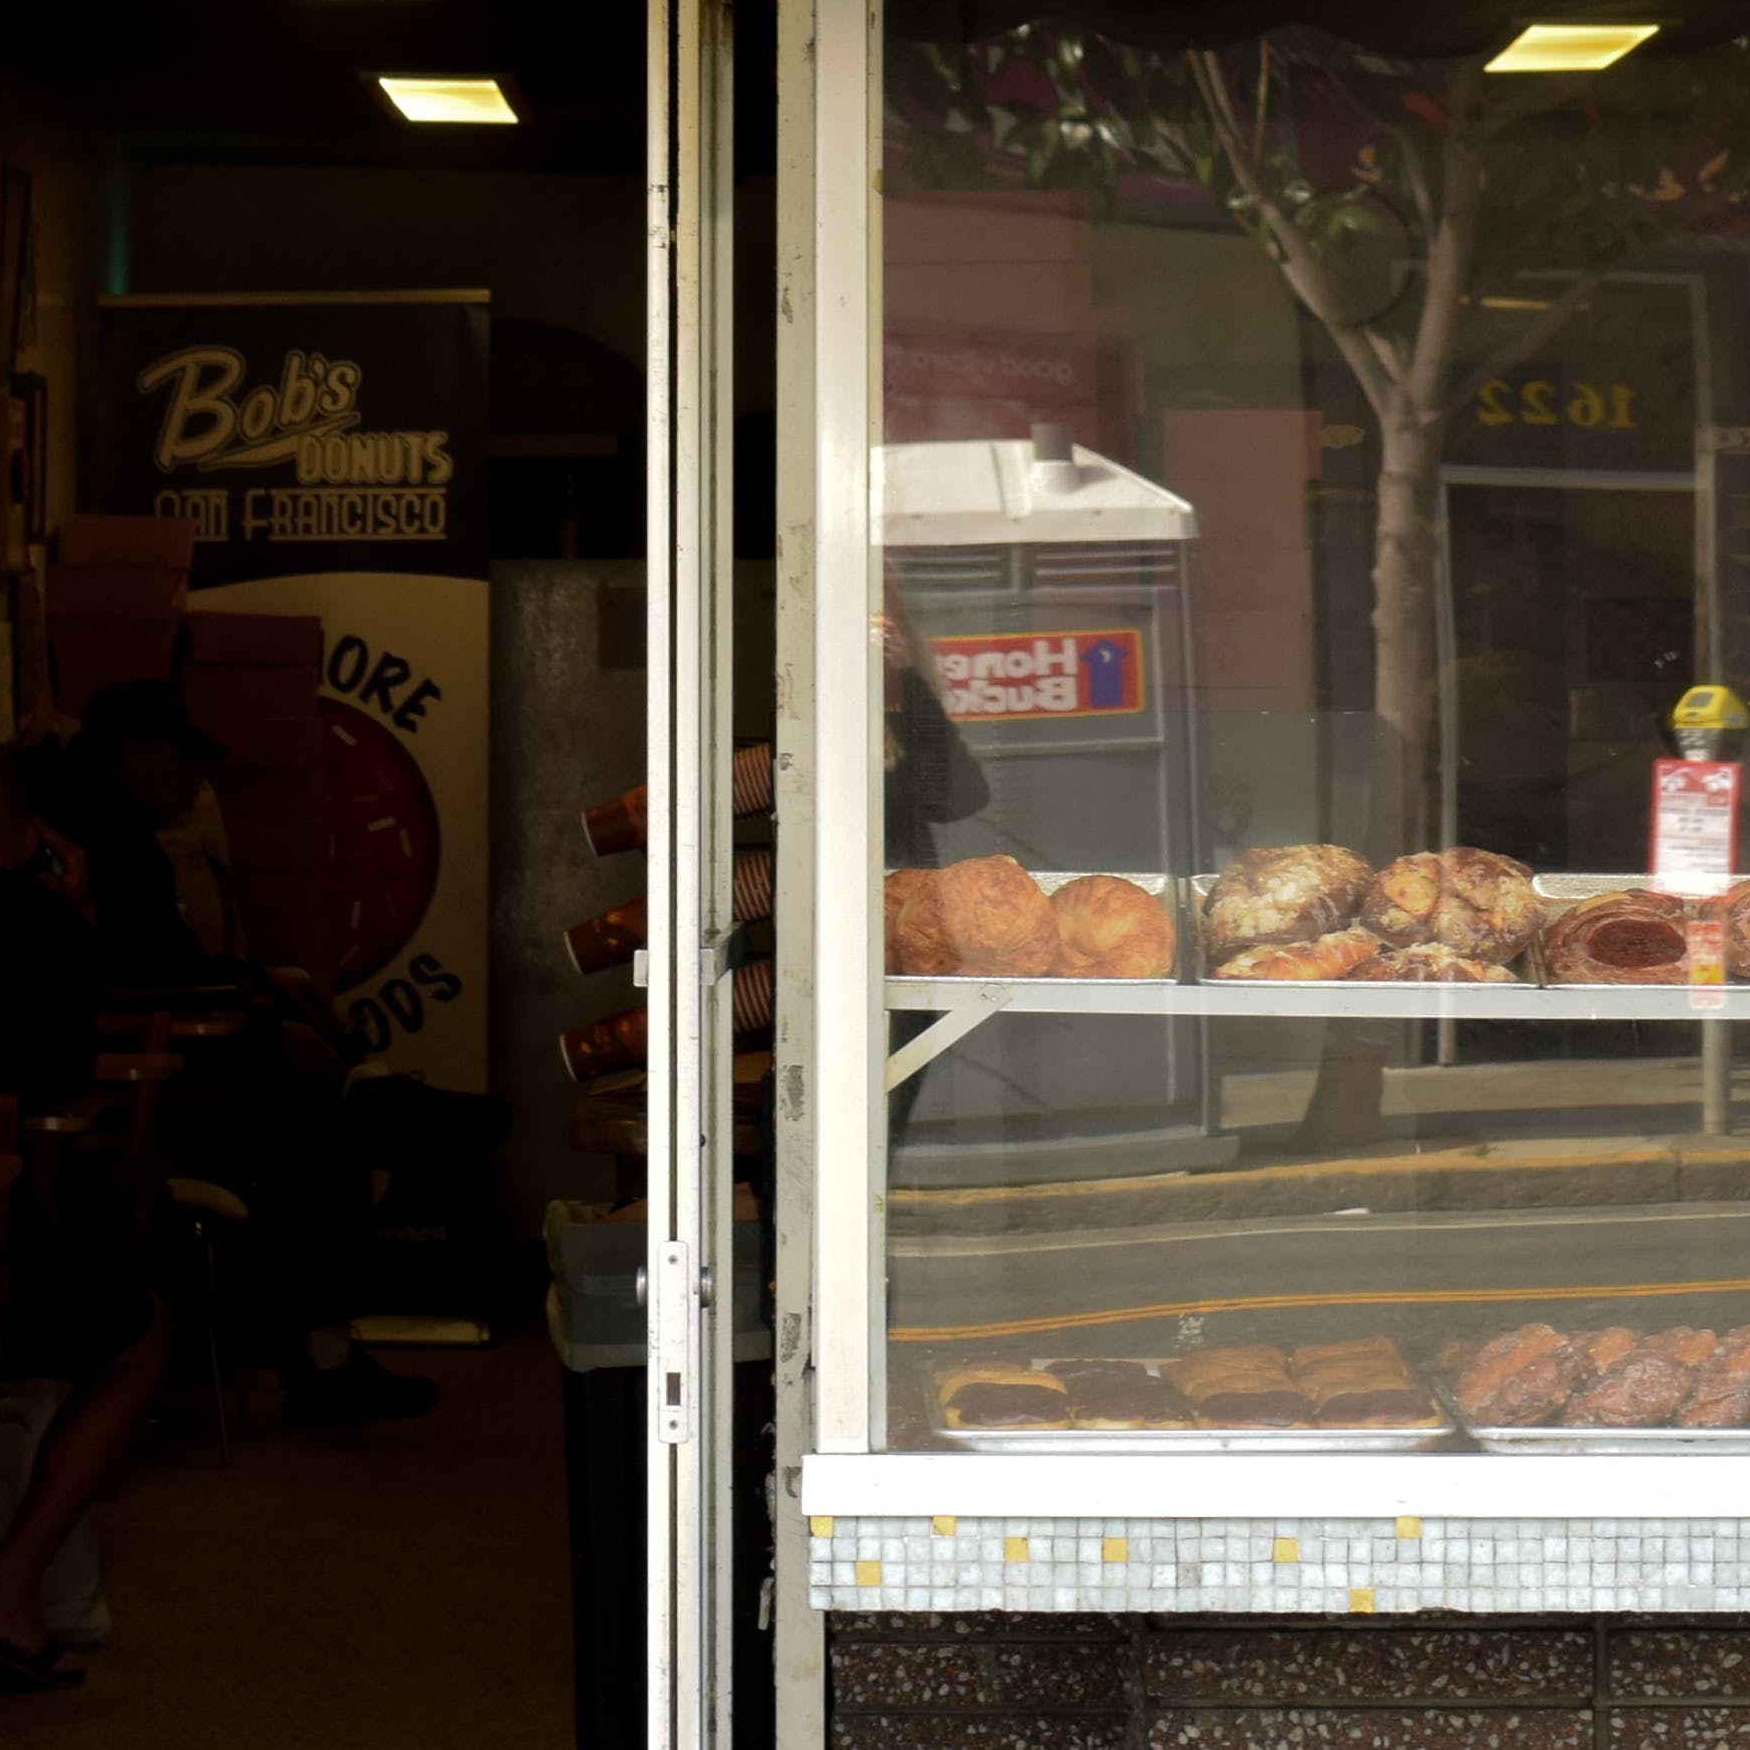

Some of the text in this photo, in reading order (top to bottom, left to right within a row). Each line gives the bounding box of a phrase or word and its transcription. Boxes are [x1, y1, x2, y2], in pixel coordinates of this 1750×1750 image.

[139, 343, 362, 473] Bob's
[296, 432, 454, 486] DONUTS
[242, 488, 448, 541] FRANCISCO
[319, 634, 444, 735] ORE
